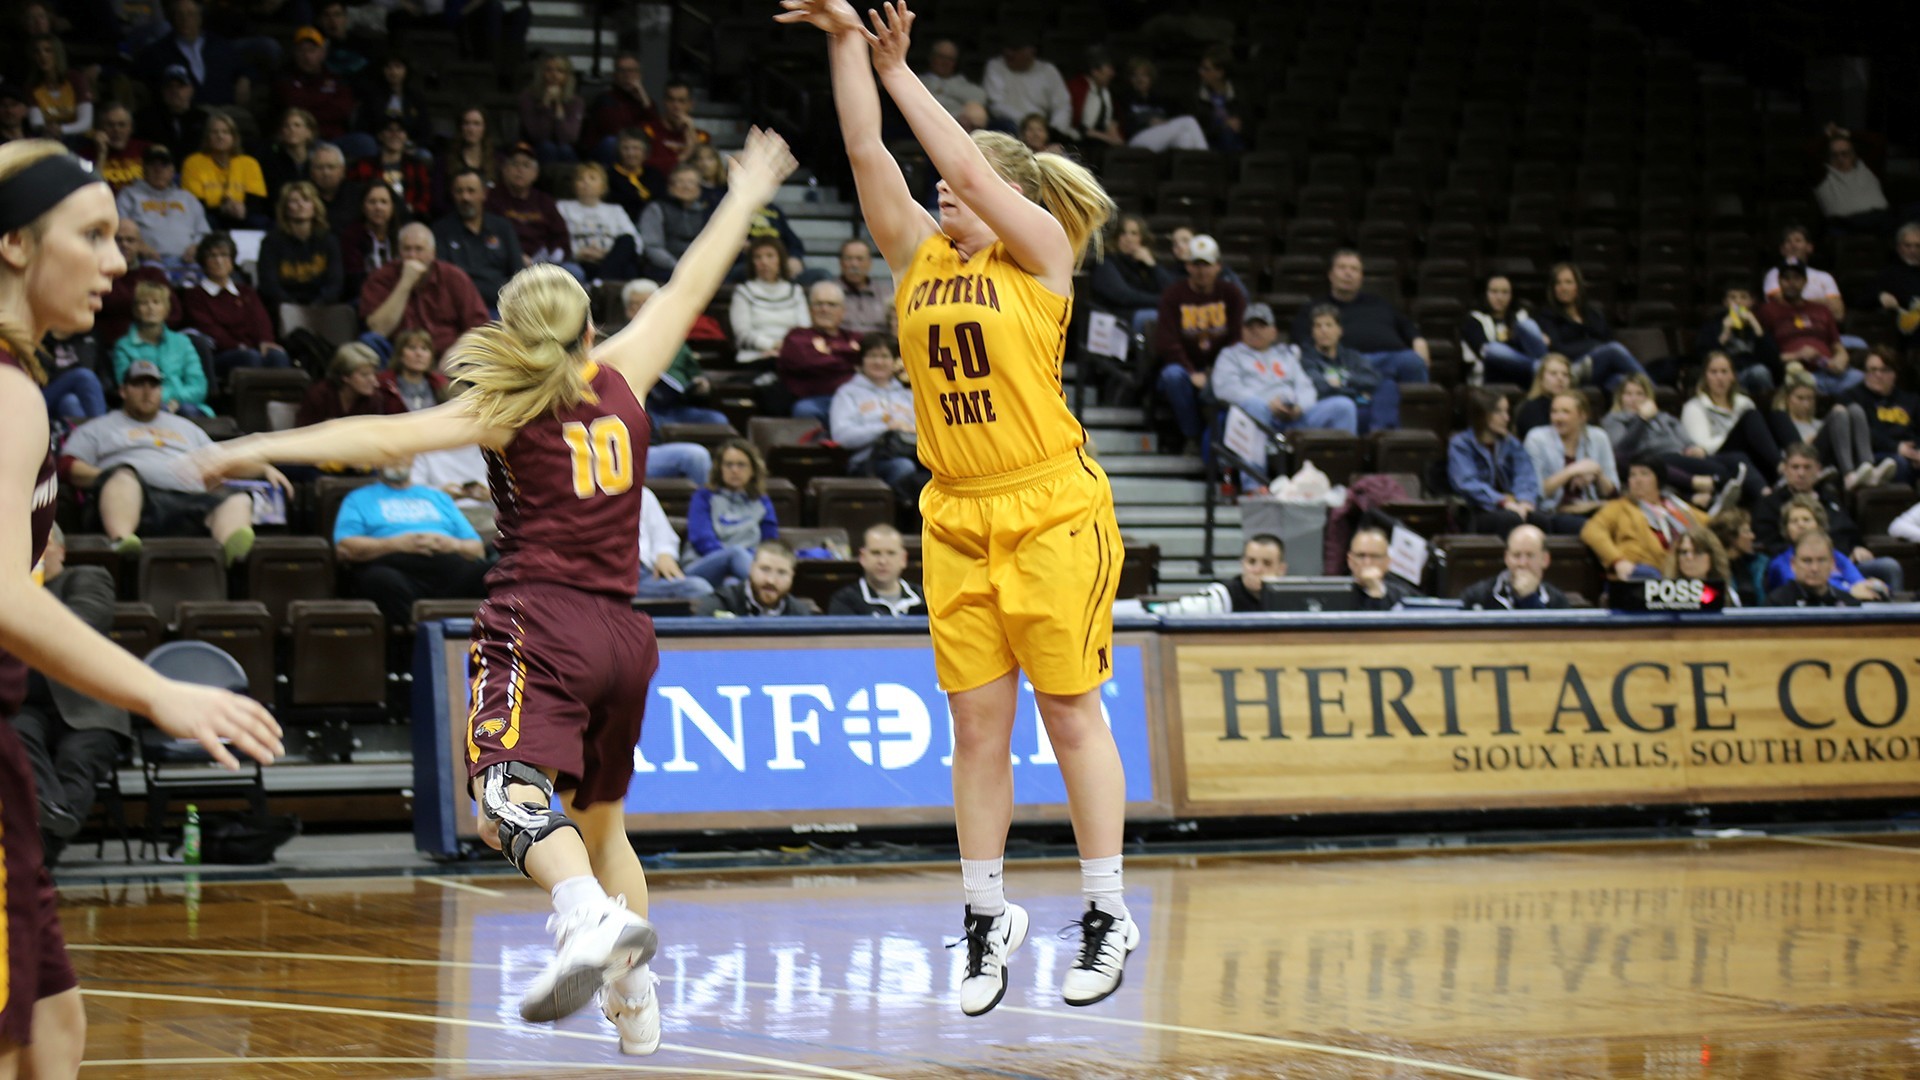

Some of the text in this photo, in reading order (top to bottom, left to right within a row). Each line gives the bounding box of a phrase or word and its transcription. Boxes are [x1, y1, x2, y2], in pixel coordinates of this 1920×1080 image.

[929, 322, 990, 381] 40
[940, 390, 996, 426] STATE
[562, 414, 633, 499] 10
[1645, 579, 1704, 603] POSS
[1211, 658, 1920, 740] HERITAGE CO
[1453, 744, 1558, 771] SIOUX
[1570, 741, 1679, 770] FALLS,
[1691, 737, 1804, 767] SOUTH
